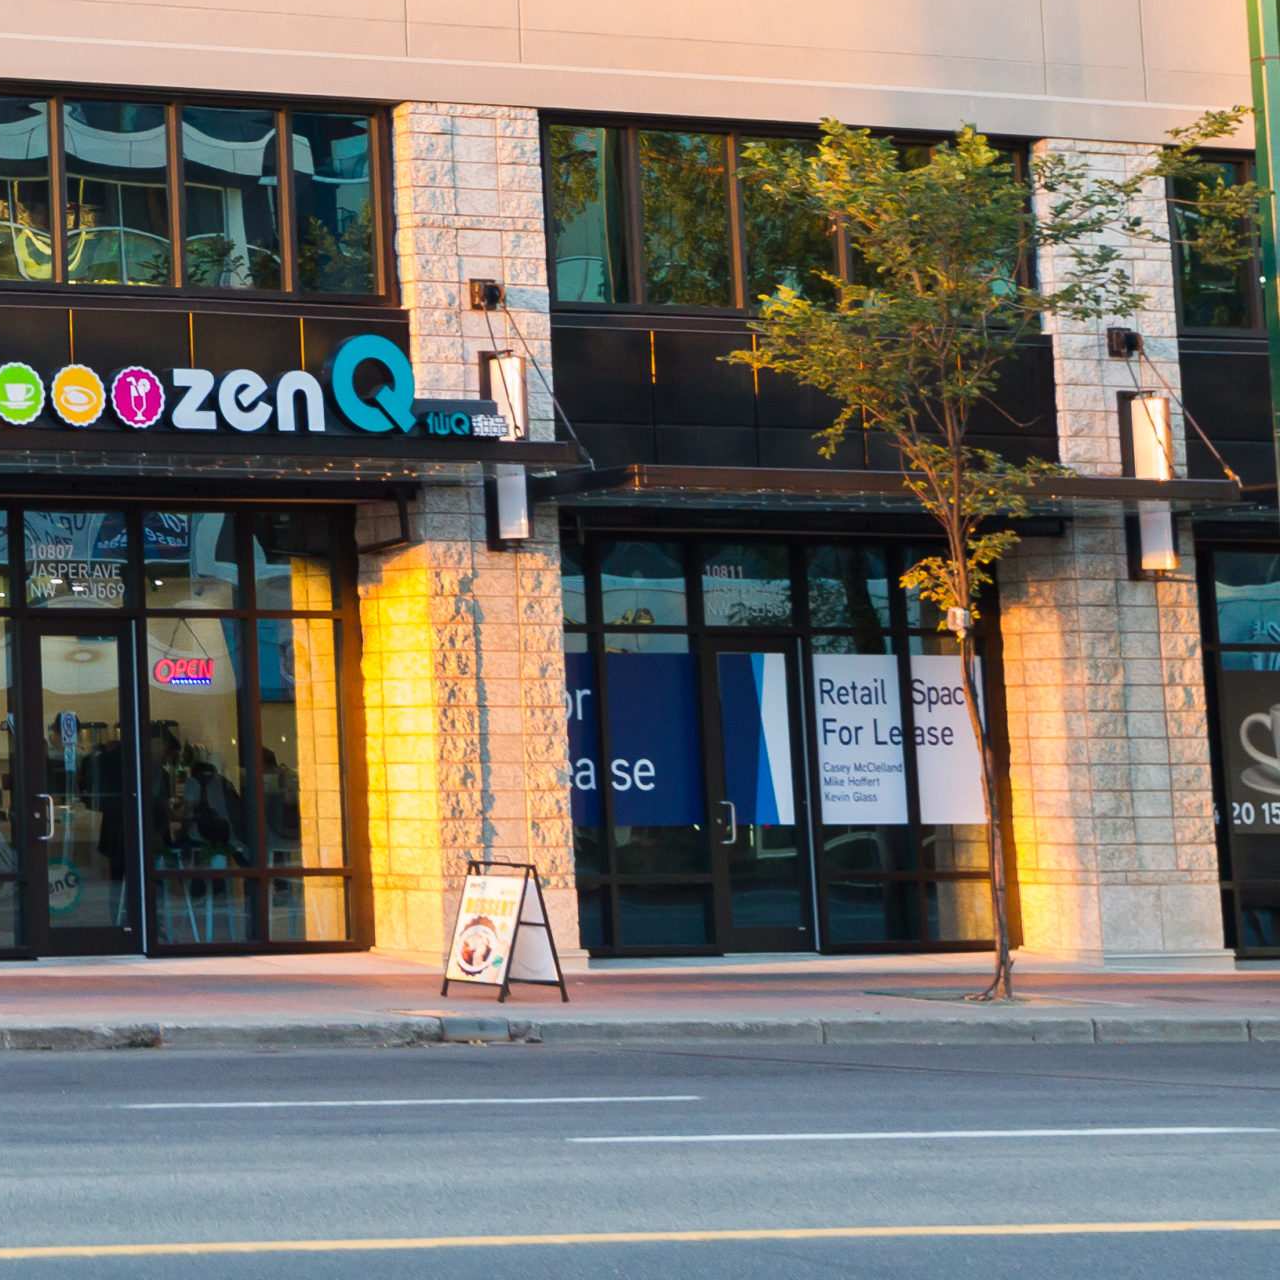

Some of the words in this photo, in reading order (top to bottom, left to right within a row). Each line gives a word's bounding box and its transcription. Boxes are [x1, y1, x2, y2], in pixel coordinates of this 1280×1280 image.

[172, 334, 418, 433] zenQ
[30, 544, 74, 560] 10807
[30, 563, 88, 579] JASPER
[93, 563, 121, 579] AVE
[705, 565, 743, 579] 10811
[30, 583, 56, 599] NW
[154, 657, 215, 684] OPEN
[819, 678, 888, 705] Retail
[912, 679, 965, 713] Spac
[822, 718, 864, 746] For
[873, 718, 954, 746] Lease
[823, 761, 851, 775] Casey
[853, 761, 904, 773] McClelland
[824, 776, 845, 787] Mike
[824, 791, 850, 802] Kevin
[853, 791, 878, 802] Glass
